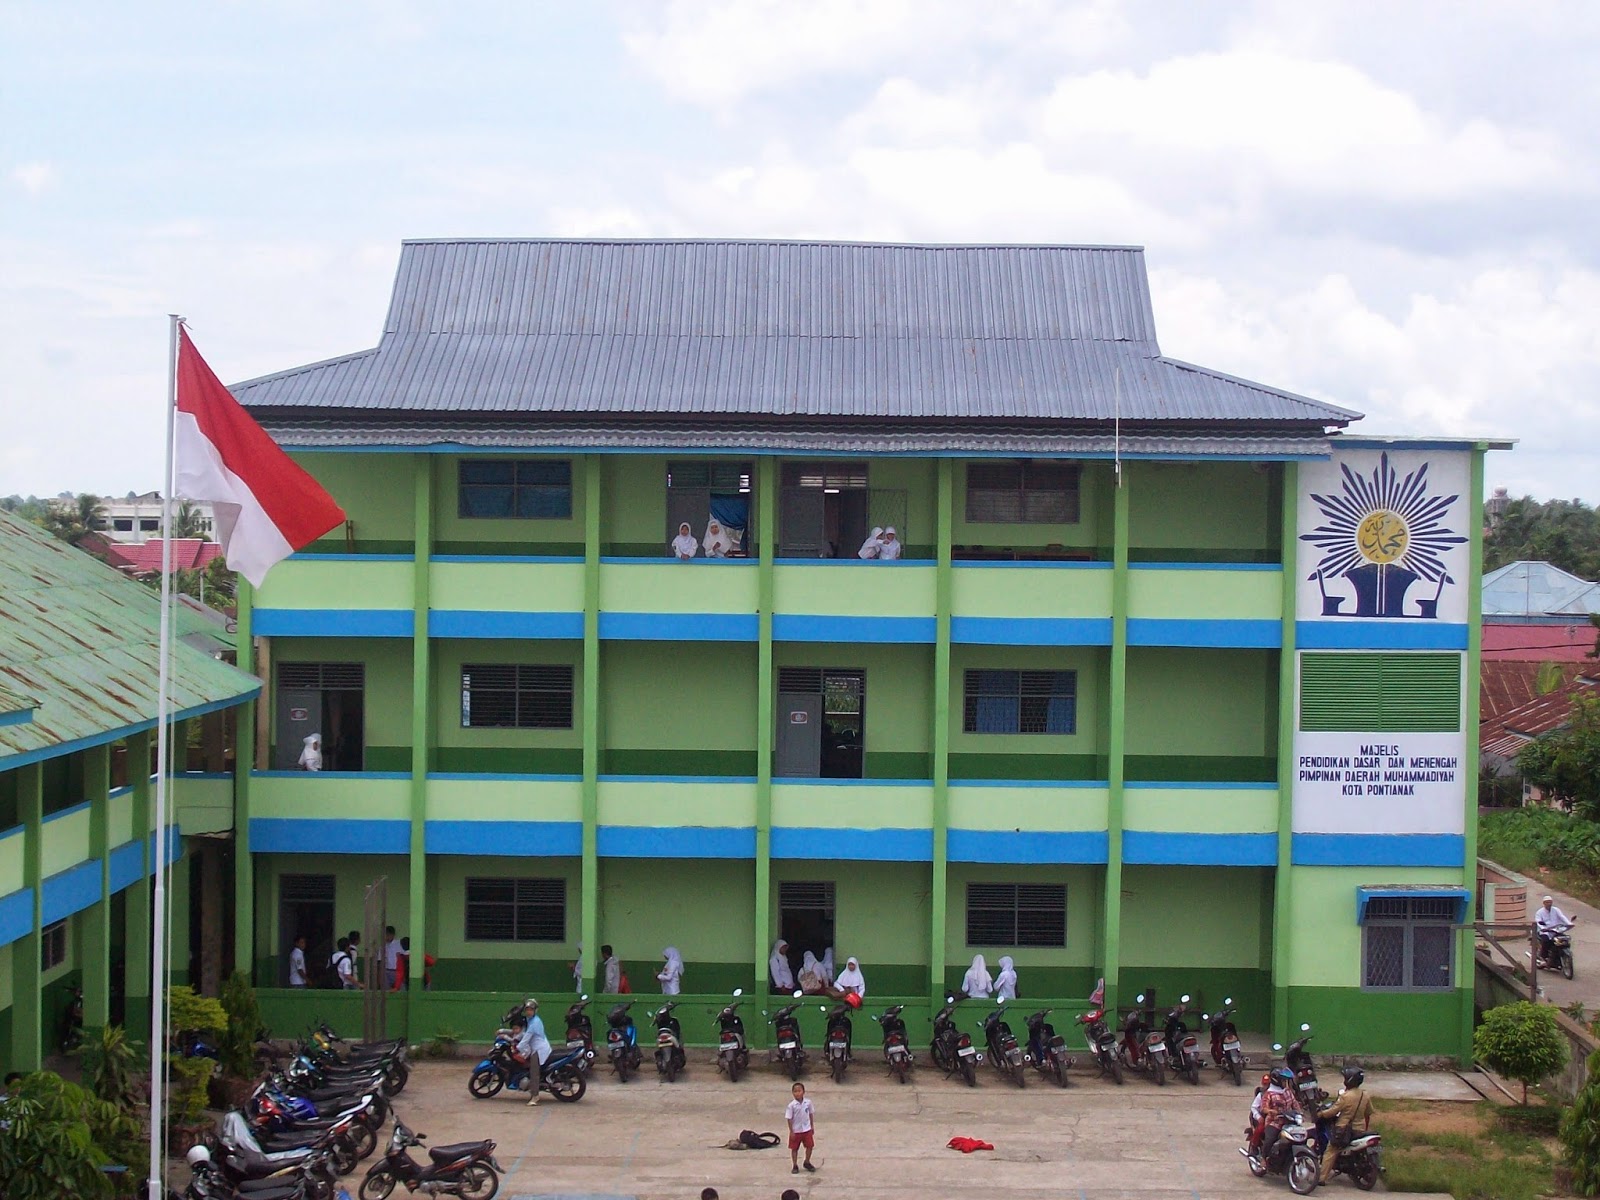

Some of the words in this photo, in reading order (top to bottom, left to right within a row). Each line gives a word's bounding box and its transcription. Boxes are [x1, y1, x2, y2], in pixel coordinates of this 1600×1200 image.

[1360, 744, 1399, 756] MAJELIS
[1299, 757, 1350, 768] PENDIDIKAN
[1354, 757, 1381, 768] DASAR
[1388, 757, 1405, 768] DAN
[1410, 757, 1458, 769] MENENGAH
[1299, 771, 1341, 782] PIMPINAN
[1345, 771, 1380, 782] DAERAH
[1384, 771, 1455, 782] MUHAMMADIYAH
[1342, 785, 1363, 796] KOTA
[1367, 785, 1415, 796] PONTIANAK
